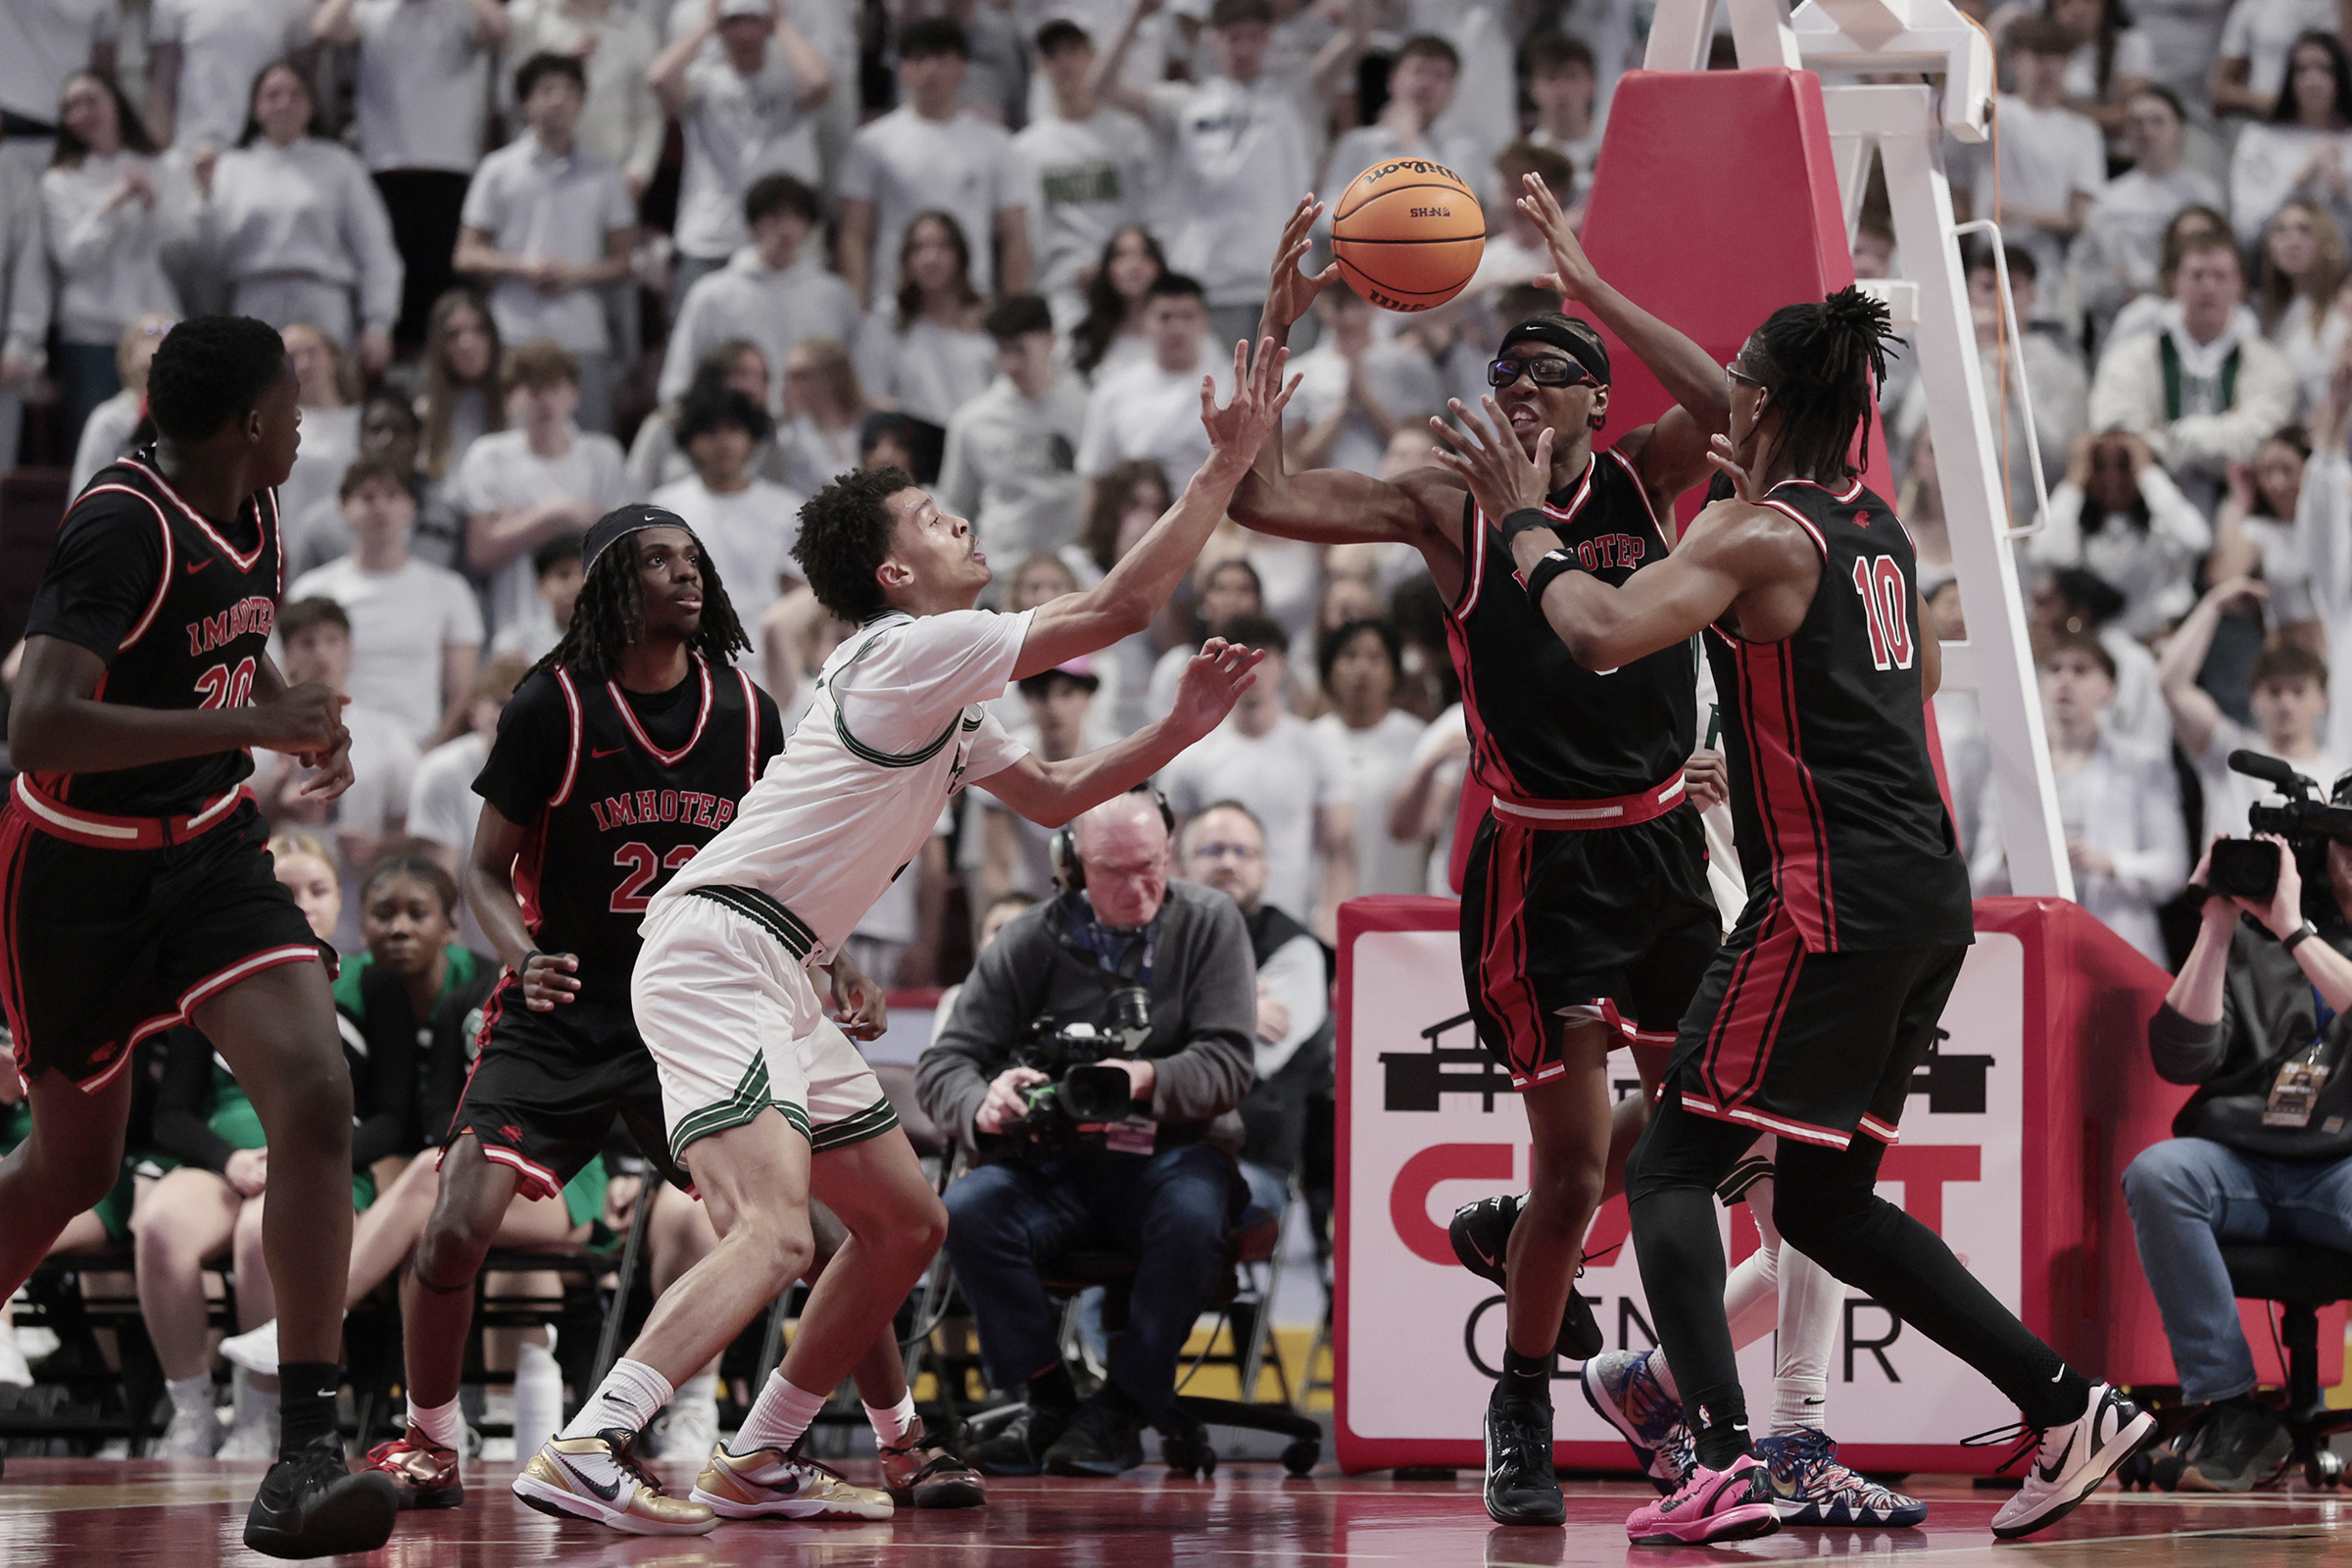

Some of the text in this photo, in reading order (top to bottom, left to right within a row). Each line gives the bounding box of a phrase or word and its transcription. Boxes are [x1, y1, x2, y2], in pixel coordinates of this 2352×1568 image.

[1363, 161, 1466, 188] Wilson
[1409, 207, 1443, 218] NFHS
[1851, 554, 1914, 670] 10
[590, 789, 735, 832] IMHOTEP
